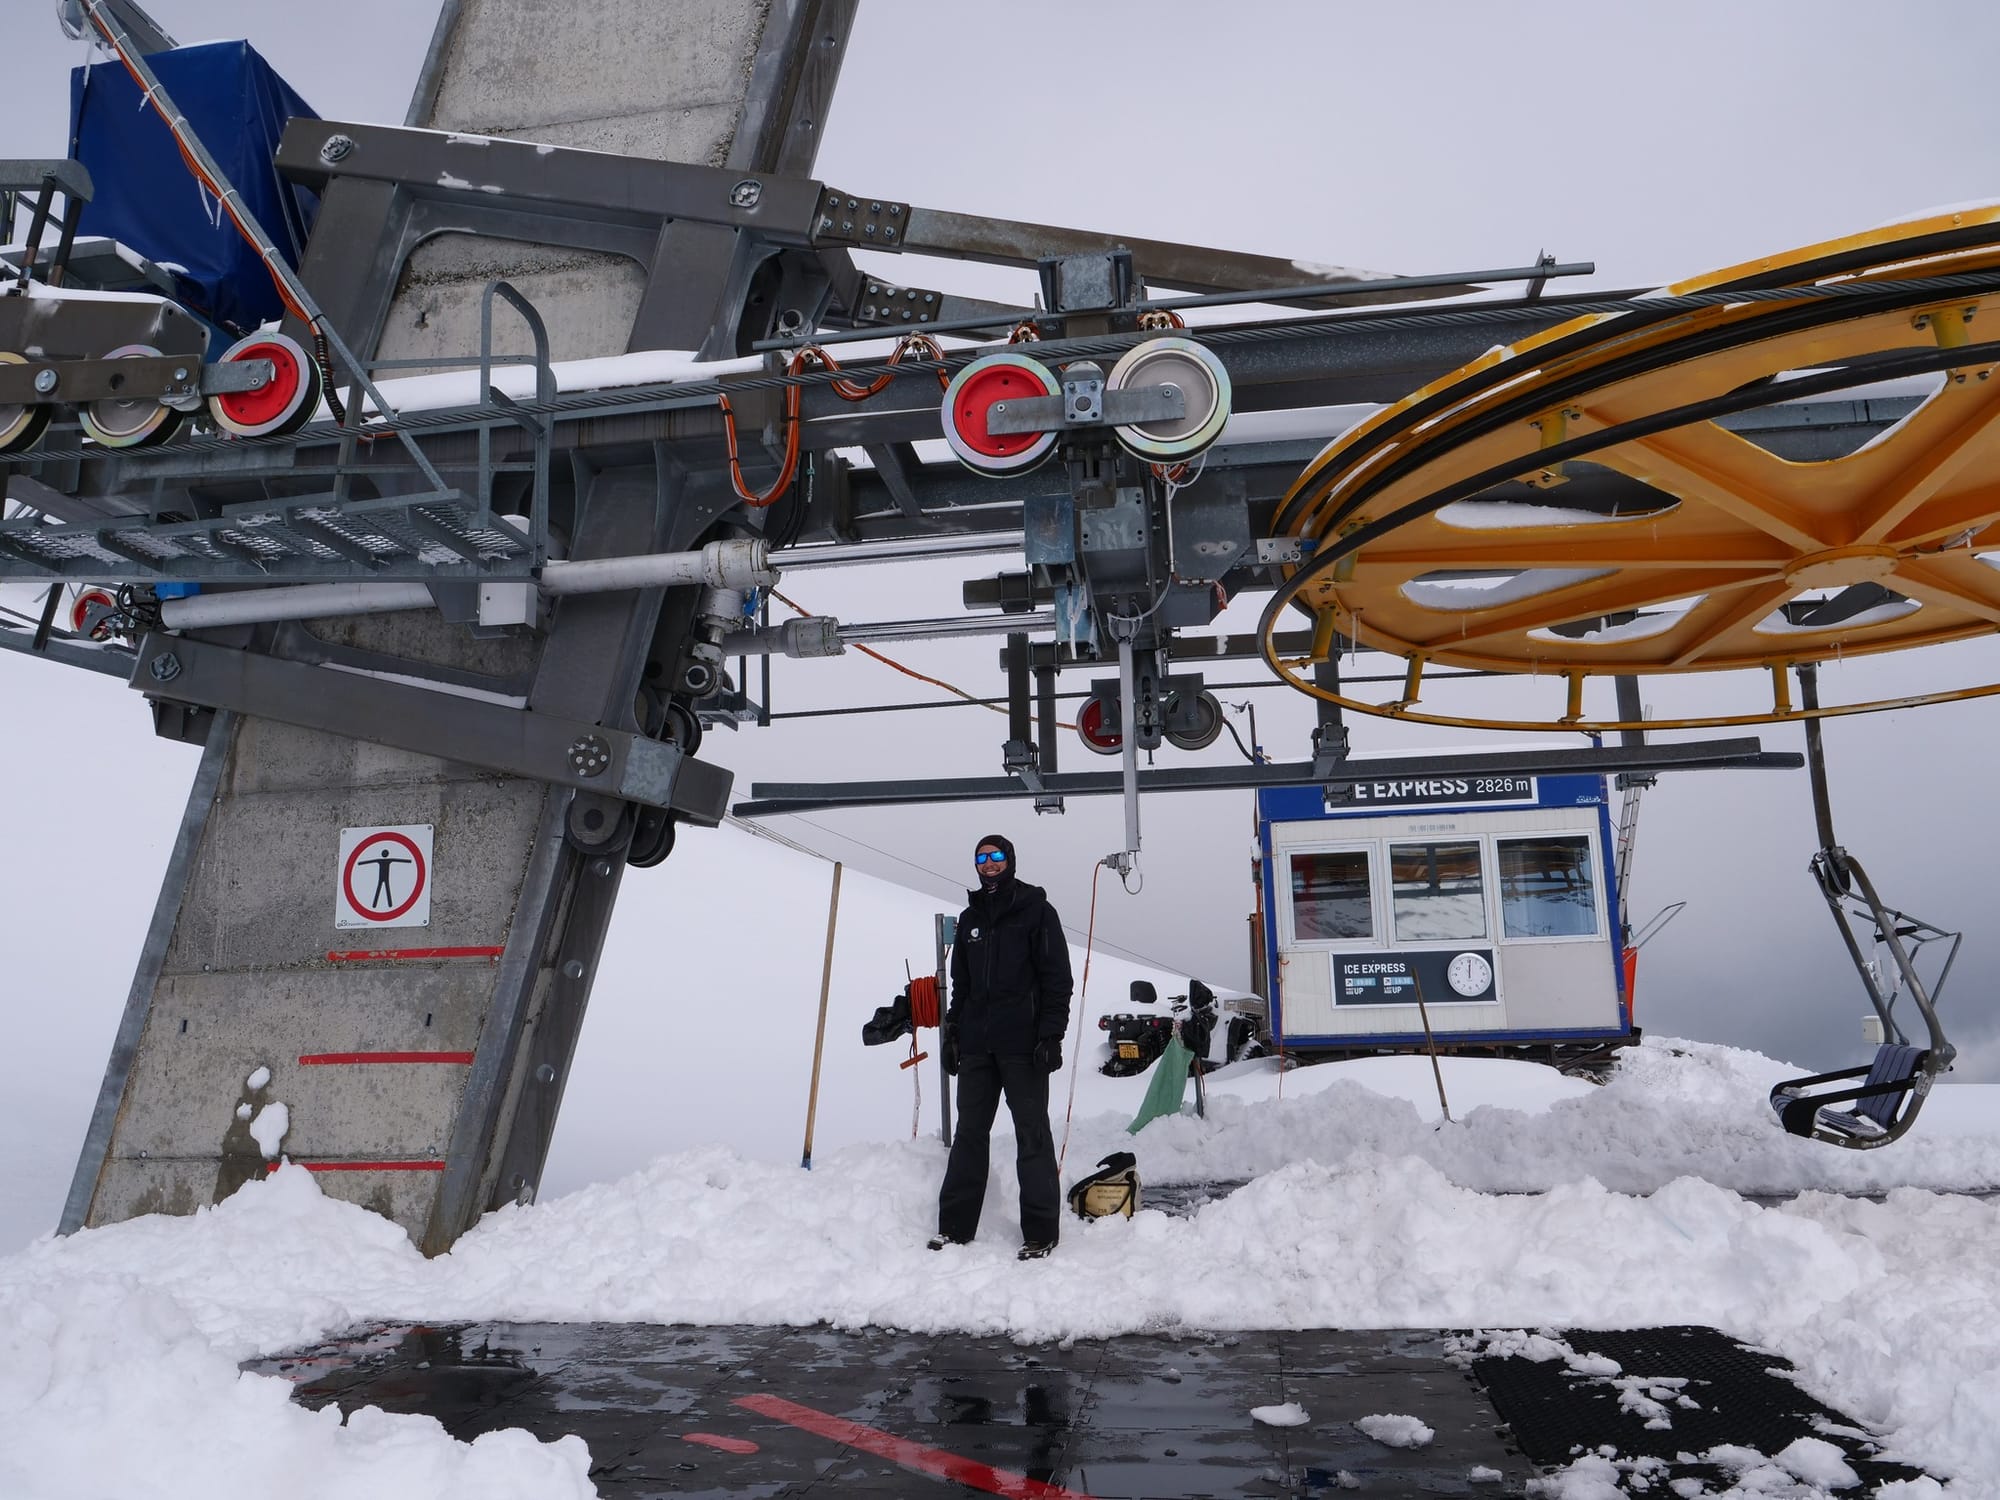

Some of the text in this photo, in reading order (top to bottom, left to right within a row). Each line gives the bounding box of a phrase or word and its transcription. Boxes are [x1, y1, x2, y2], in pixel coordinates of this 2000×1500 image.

[1374, 779, 1469, 798] EXPRESS
[1476, 778, 1512, 793] 2826
[1516, 779, 1529, 791] m
[1344, 963, 1406, 974] ICE EXPRESS
[1354, 987, 1364, 995] UP
[1392, 986, 1402, 994] UP
